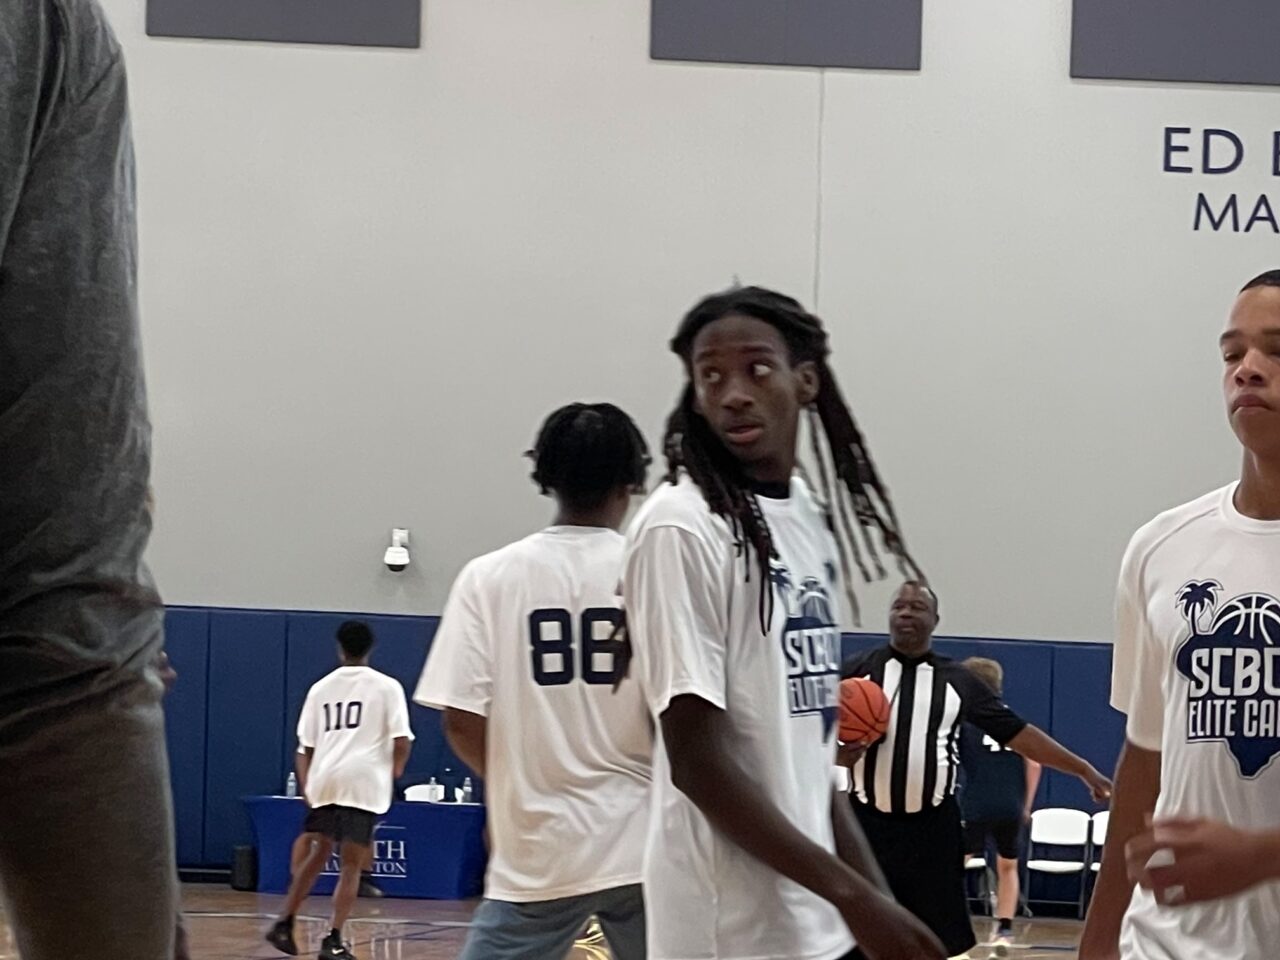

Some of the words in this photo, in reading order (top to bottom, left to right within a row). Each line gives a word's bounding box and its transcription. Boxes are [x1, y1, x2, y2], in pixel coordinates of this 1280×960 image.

[1162, 126, 1245, 175] ED
[529, 607, 630, 687] 88
[323, 701, 363, 732] 110
[1188, 700, 1236, 737] ELITE
